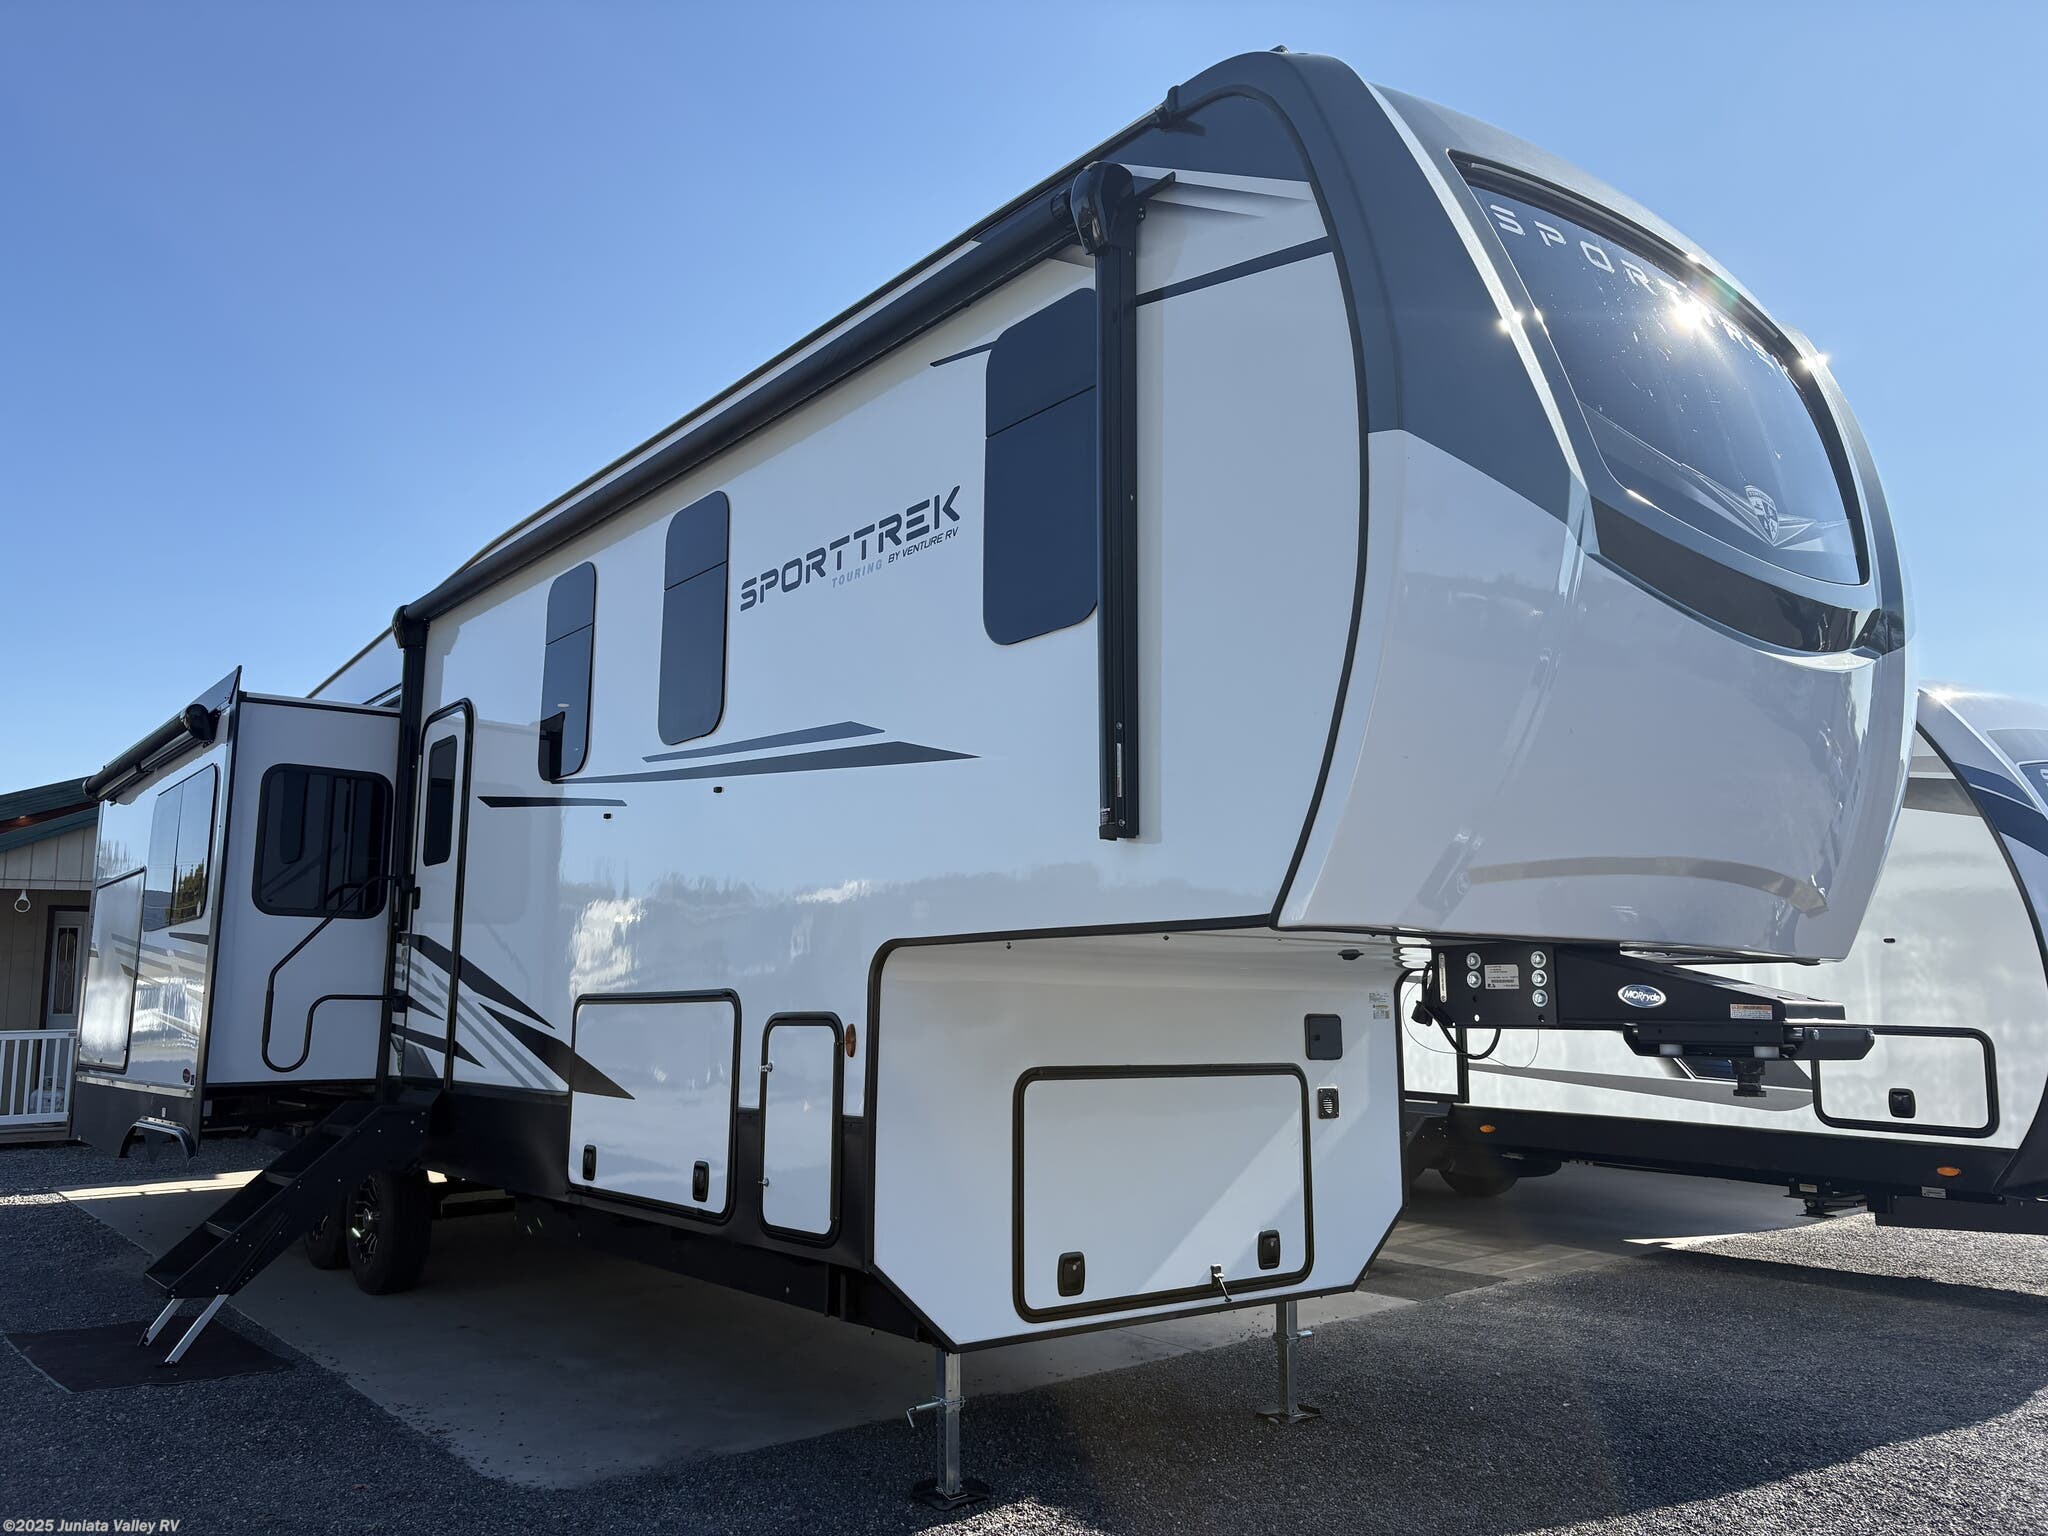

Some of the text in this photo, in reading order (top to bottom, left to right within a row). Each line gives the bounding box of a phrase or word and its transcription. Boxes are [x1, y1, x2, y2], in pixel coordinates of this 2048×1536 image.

[1490, 204, 1802, 390] SPORTRE
[740, 485, 961, 612] SPORTTREK
[832, 526, 959, 588] TOURING BY VENTURE RV
